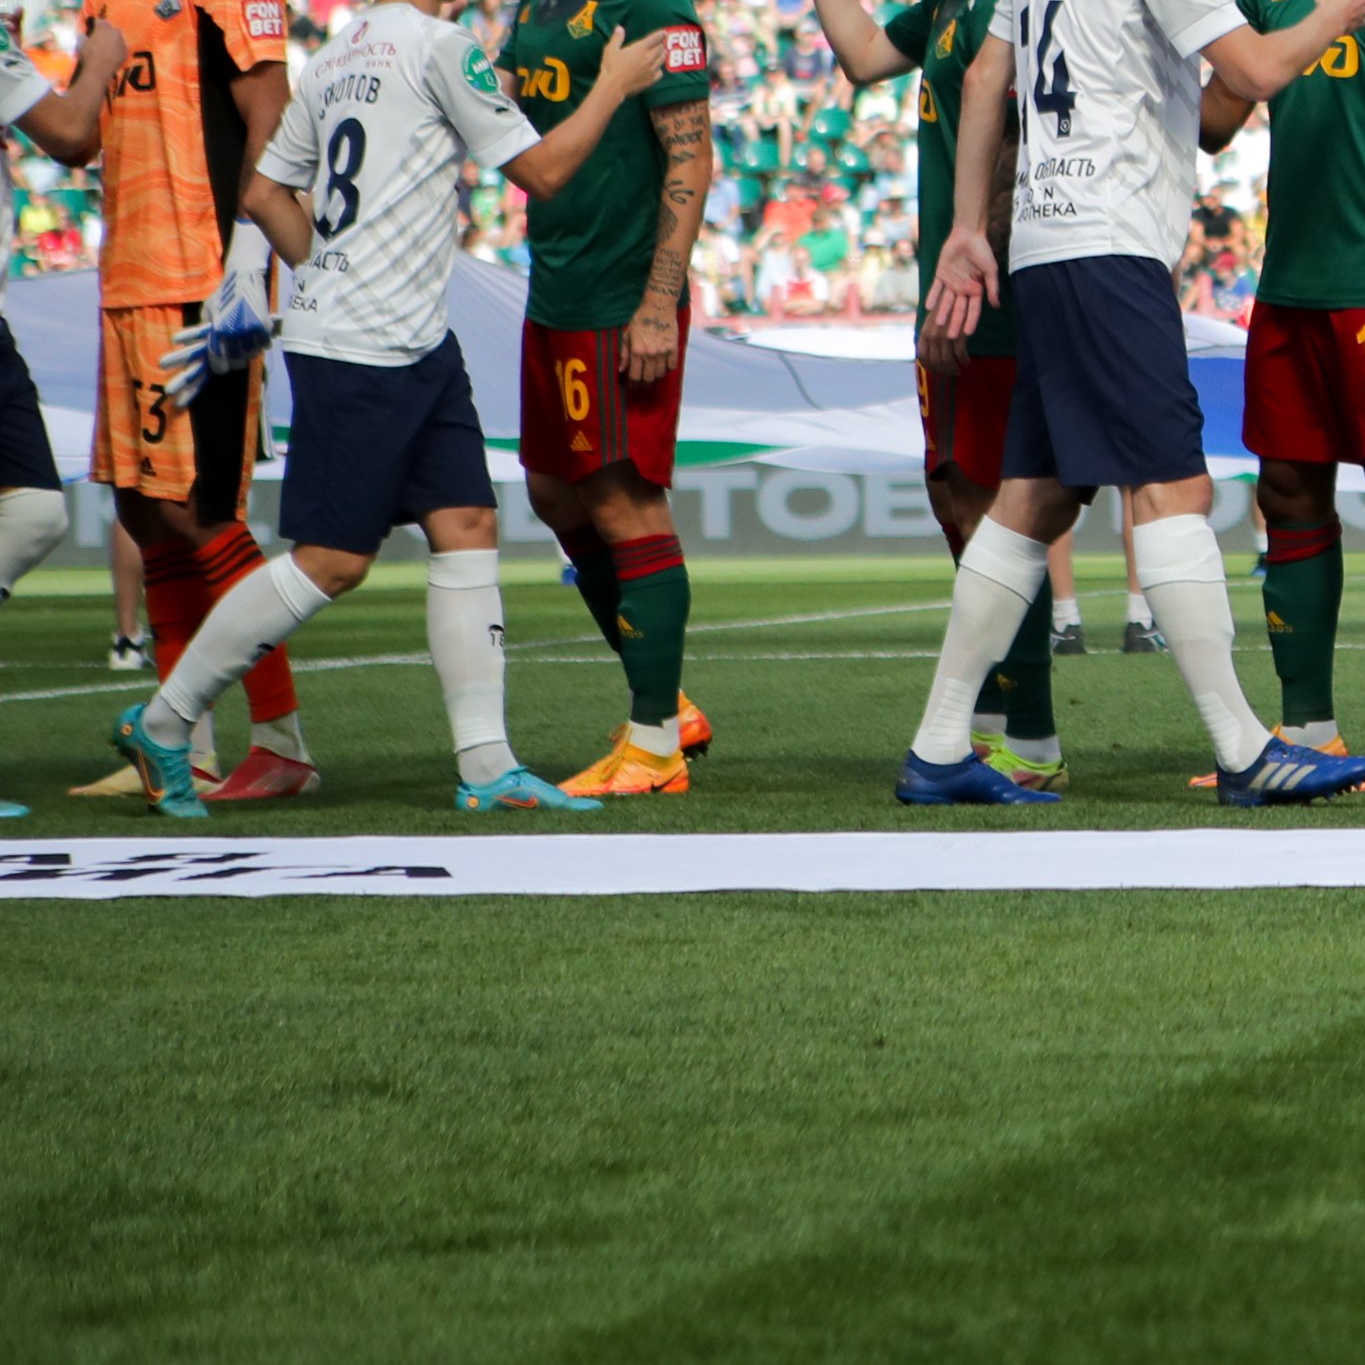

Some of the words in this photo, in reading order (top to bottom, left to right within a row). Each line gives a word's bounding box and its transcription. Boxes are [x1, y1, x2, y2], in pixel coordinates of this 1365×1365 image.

[245, 1, 280, 21] FON
[249, 20, 283, 38] BET
[666, 31, 700, 51] FON
[668, 48, 702, 68] BET
